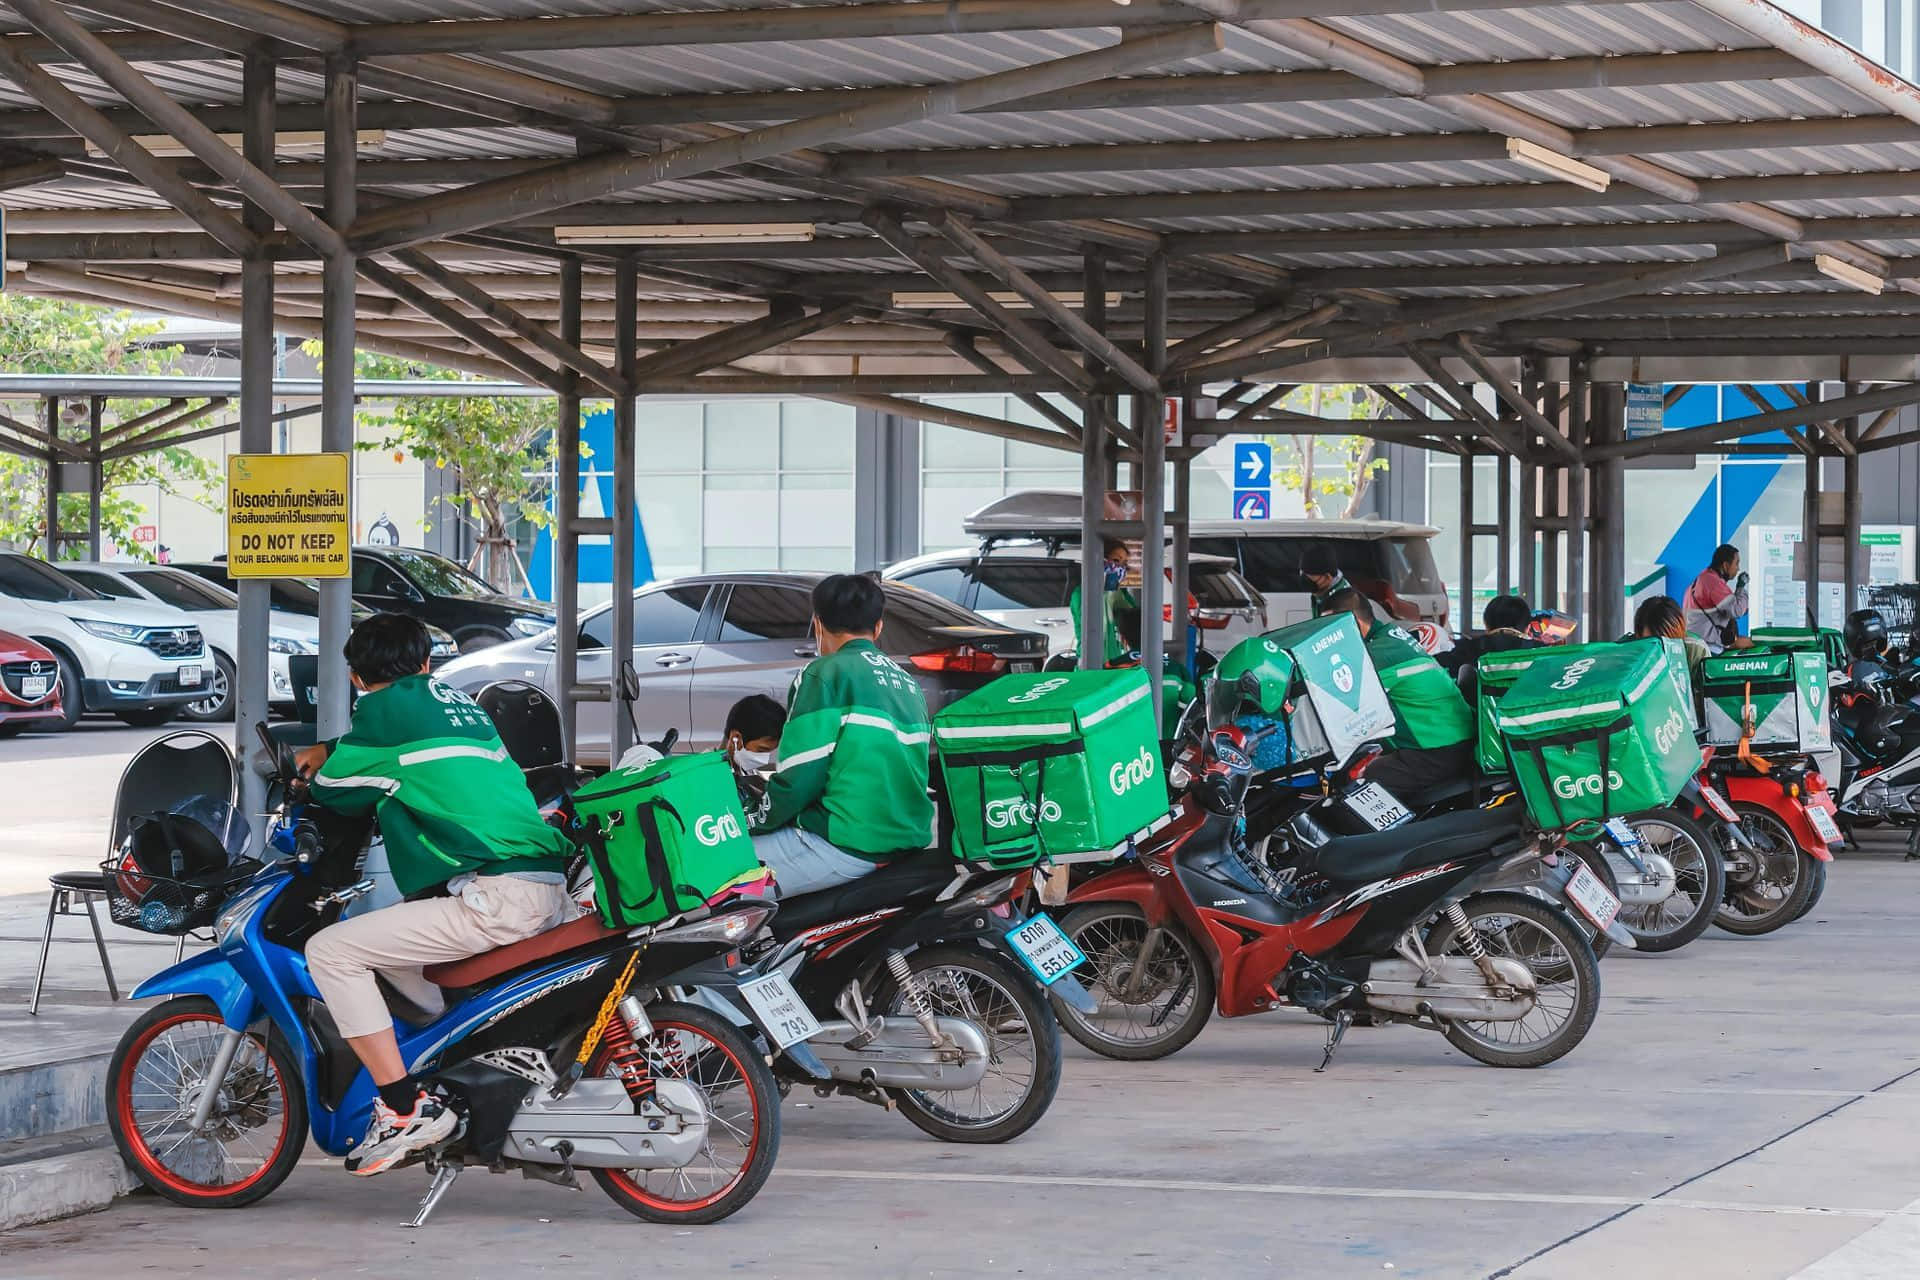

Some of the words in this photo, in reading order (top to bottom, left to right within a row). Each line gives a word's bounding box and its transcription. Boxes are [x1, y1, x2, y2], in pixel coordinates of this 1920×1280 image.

[241, 534, 261, 550] DO
[267, 534, 295, 550] NOT
[301, 533, 335, 549] KEEP
[234, 554, 254, 564] YOUR
[256, 554, 299, 563] BELONGING
[301, 554, 309, 563] IN
[312, 554, 325, 563] THE
[328, 554, 344, 563] CAR
[1550, 658, 1596, 690] Grab
[1007, 678, 1070, 704] Grab
[1654, 706, 1684, 755] Grab
[1109, 745, 1154, 797] Grab
[985, 792, 1062, 828] Grab
[1374, 806, 1402, 827] 3007
[1213, 898, 1247, 907] HONDA
[1041, 950, 1075, 977] 5510
[781, 1016, 809, 1039] 793
